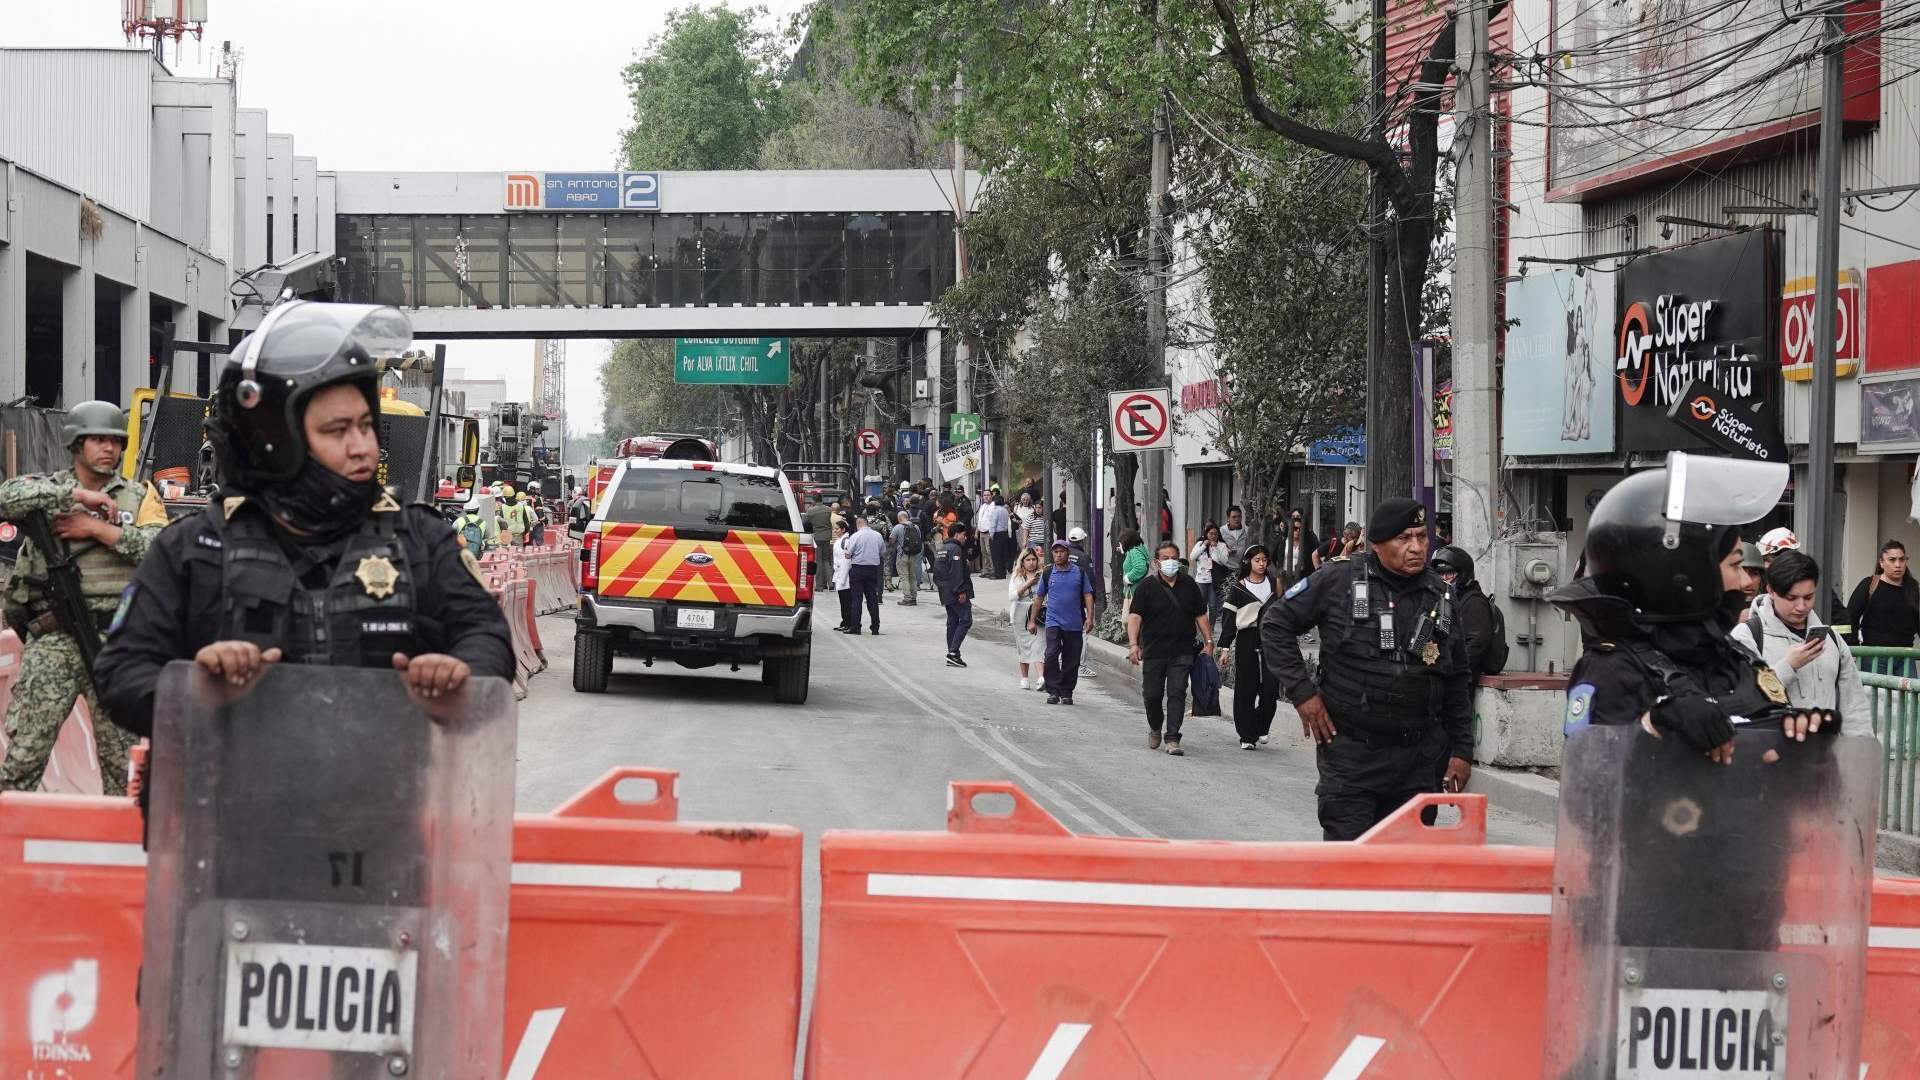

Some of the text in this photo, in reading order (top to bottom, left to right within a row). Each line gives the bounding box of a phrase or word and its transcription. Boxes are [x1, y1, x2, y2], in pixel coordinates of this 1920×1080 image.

[566, 193, 599, 201] ABAD
[567, 180, 618, 189] ANTONIO
[625, 175, 656, 207] 2
[1655, 294, 1712, 359] Súper
[1784, 296, 1848, 363] OXO
[683, 355, 694, 371] Por
[697, 356, 713, 372] ALVA
[740, 356, 759, 372] CHITL
[953, 417, 977, 440] rtp
[1718, 408, 1753, 434] Súper
[943, 440, 981, 458] PRECAUCIO
[1711, 417, 1769, 459] Naturista
[942, 454, 960, 464] ZONA
[239, 962, 402, 1036] POLICIA
[1628, 1006, 1776, 1072] POLICIA
